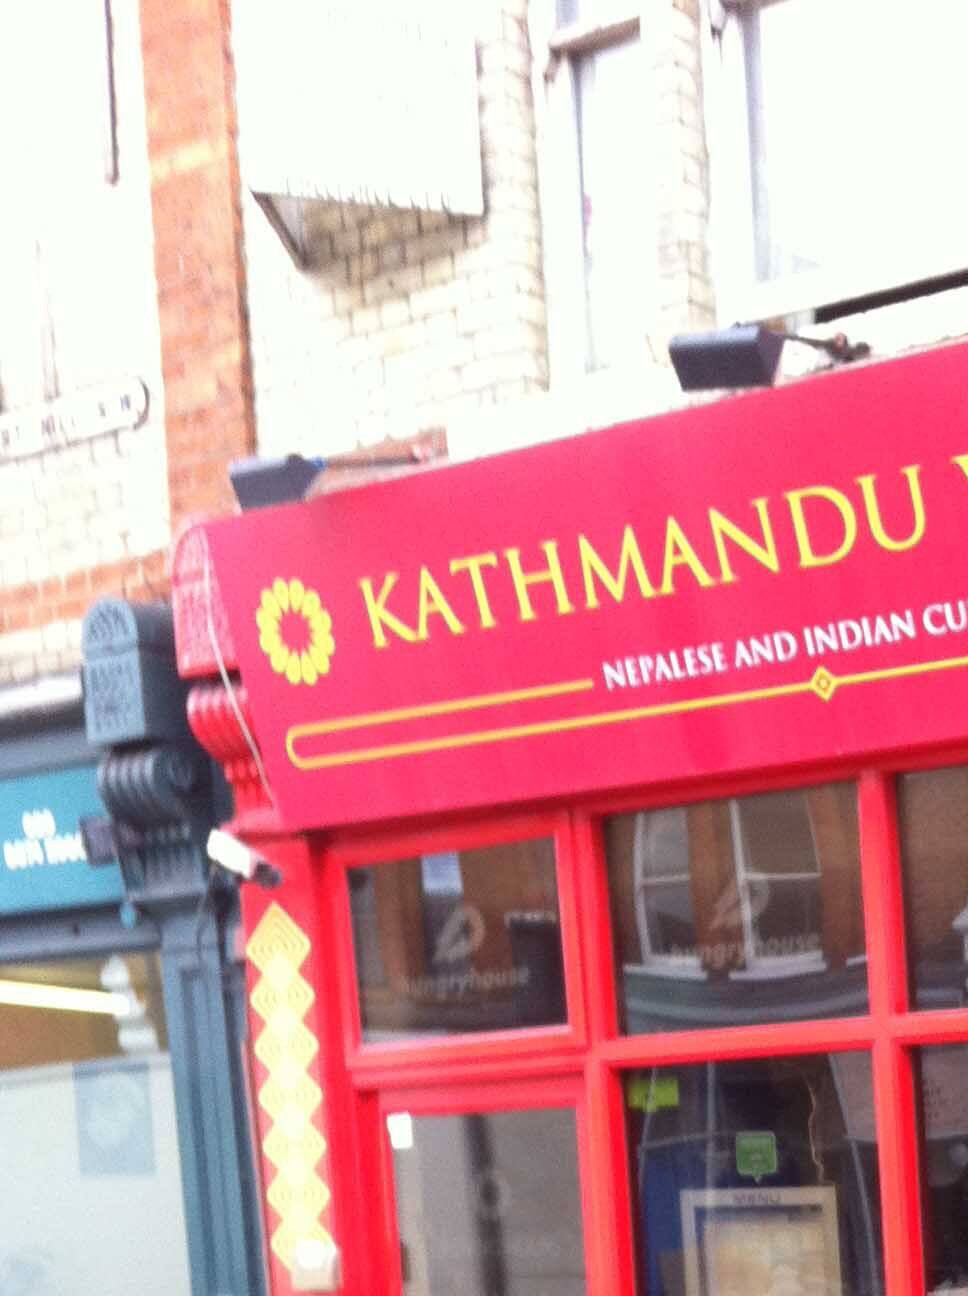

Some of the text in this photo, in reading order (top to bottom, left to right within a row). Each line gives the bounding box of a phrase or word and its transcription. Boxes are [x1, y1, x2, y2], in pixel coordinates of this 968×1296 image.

[359, 465, 926, 649] KATHMANDU
[602, 642, 727, 691] NEPALESE
[734, 631, 798, 669] AND
[802, 609, 917, 656] INDIAN
